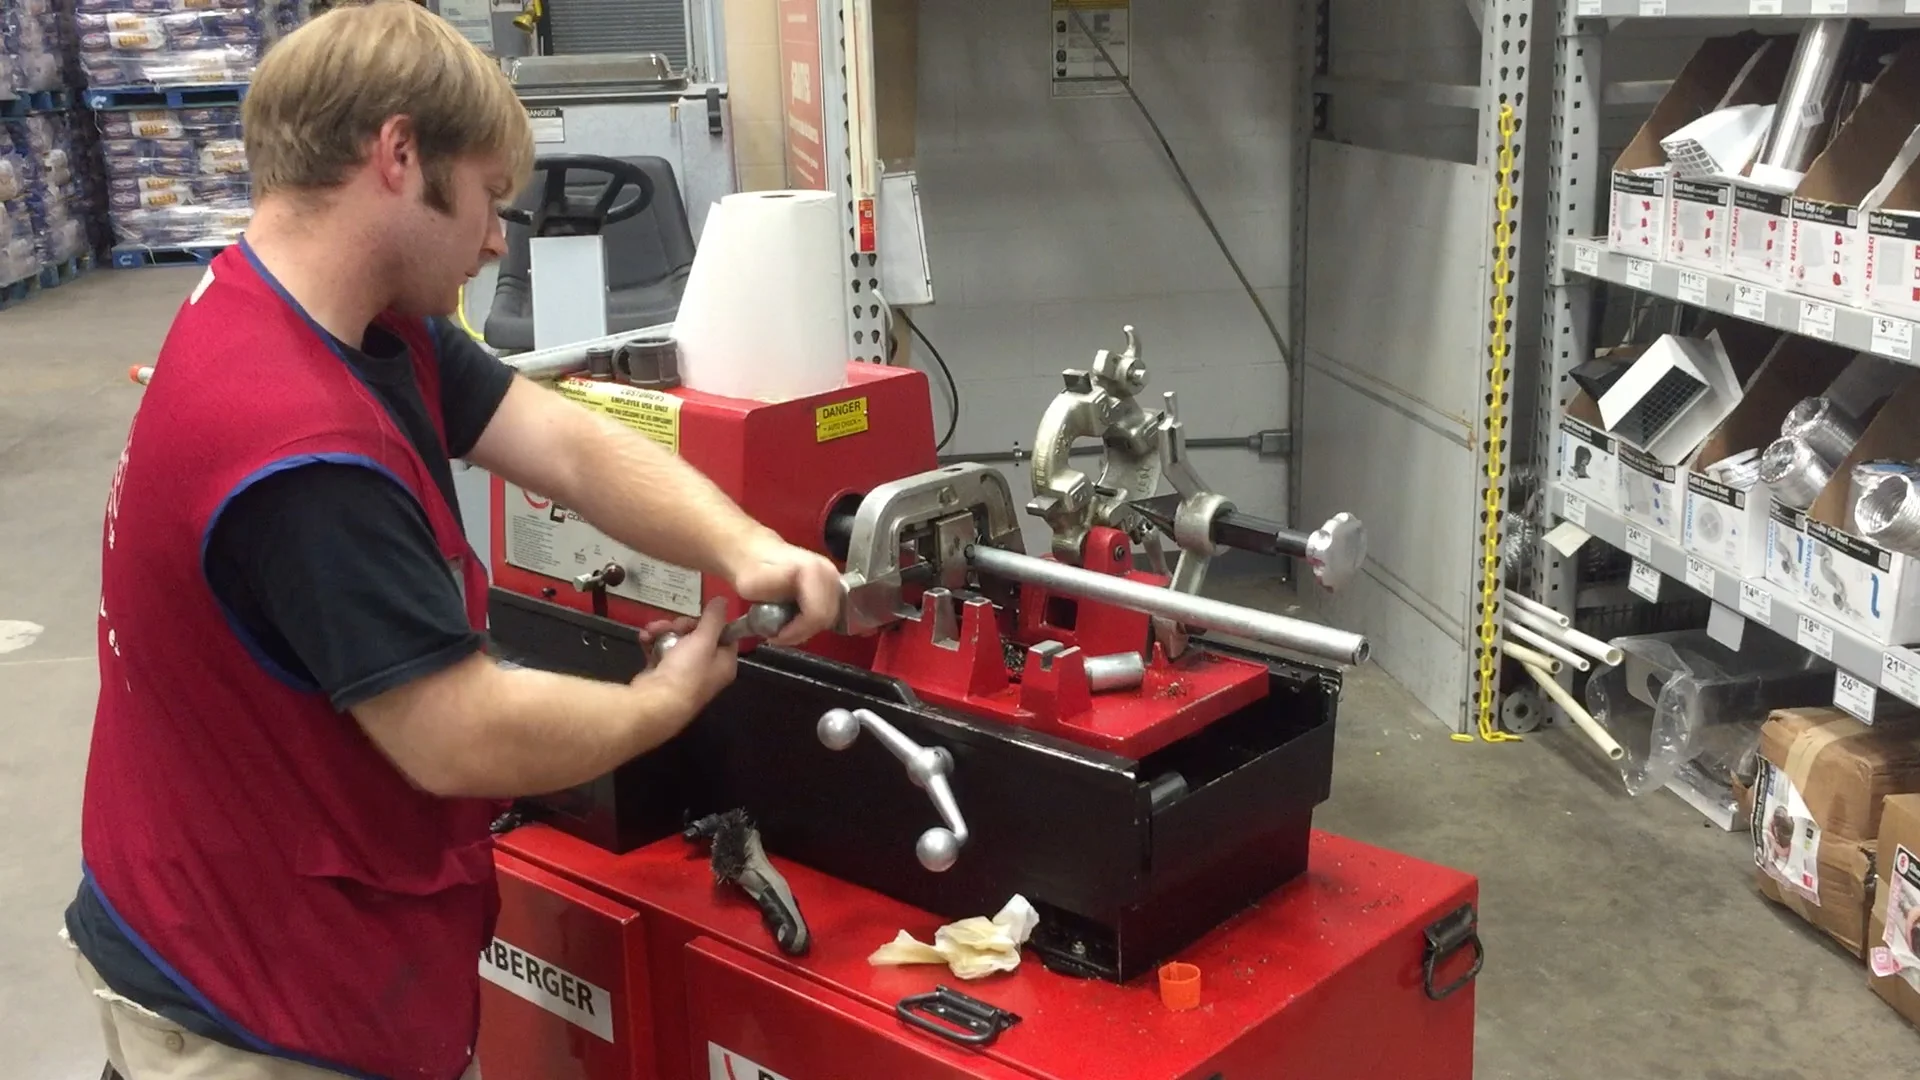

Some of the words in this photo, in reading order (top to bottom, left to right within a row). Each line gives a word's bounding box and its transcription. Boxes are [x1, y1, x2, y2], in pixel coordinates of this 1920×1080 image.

[1790, 220, 1799, 261] DRYER
[1866, 236, 1875, 280] DRYER
[823, 401, 861, 419] DANGER
[1804, 539, 1813, 581] VENTING
